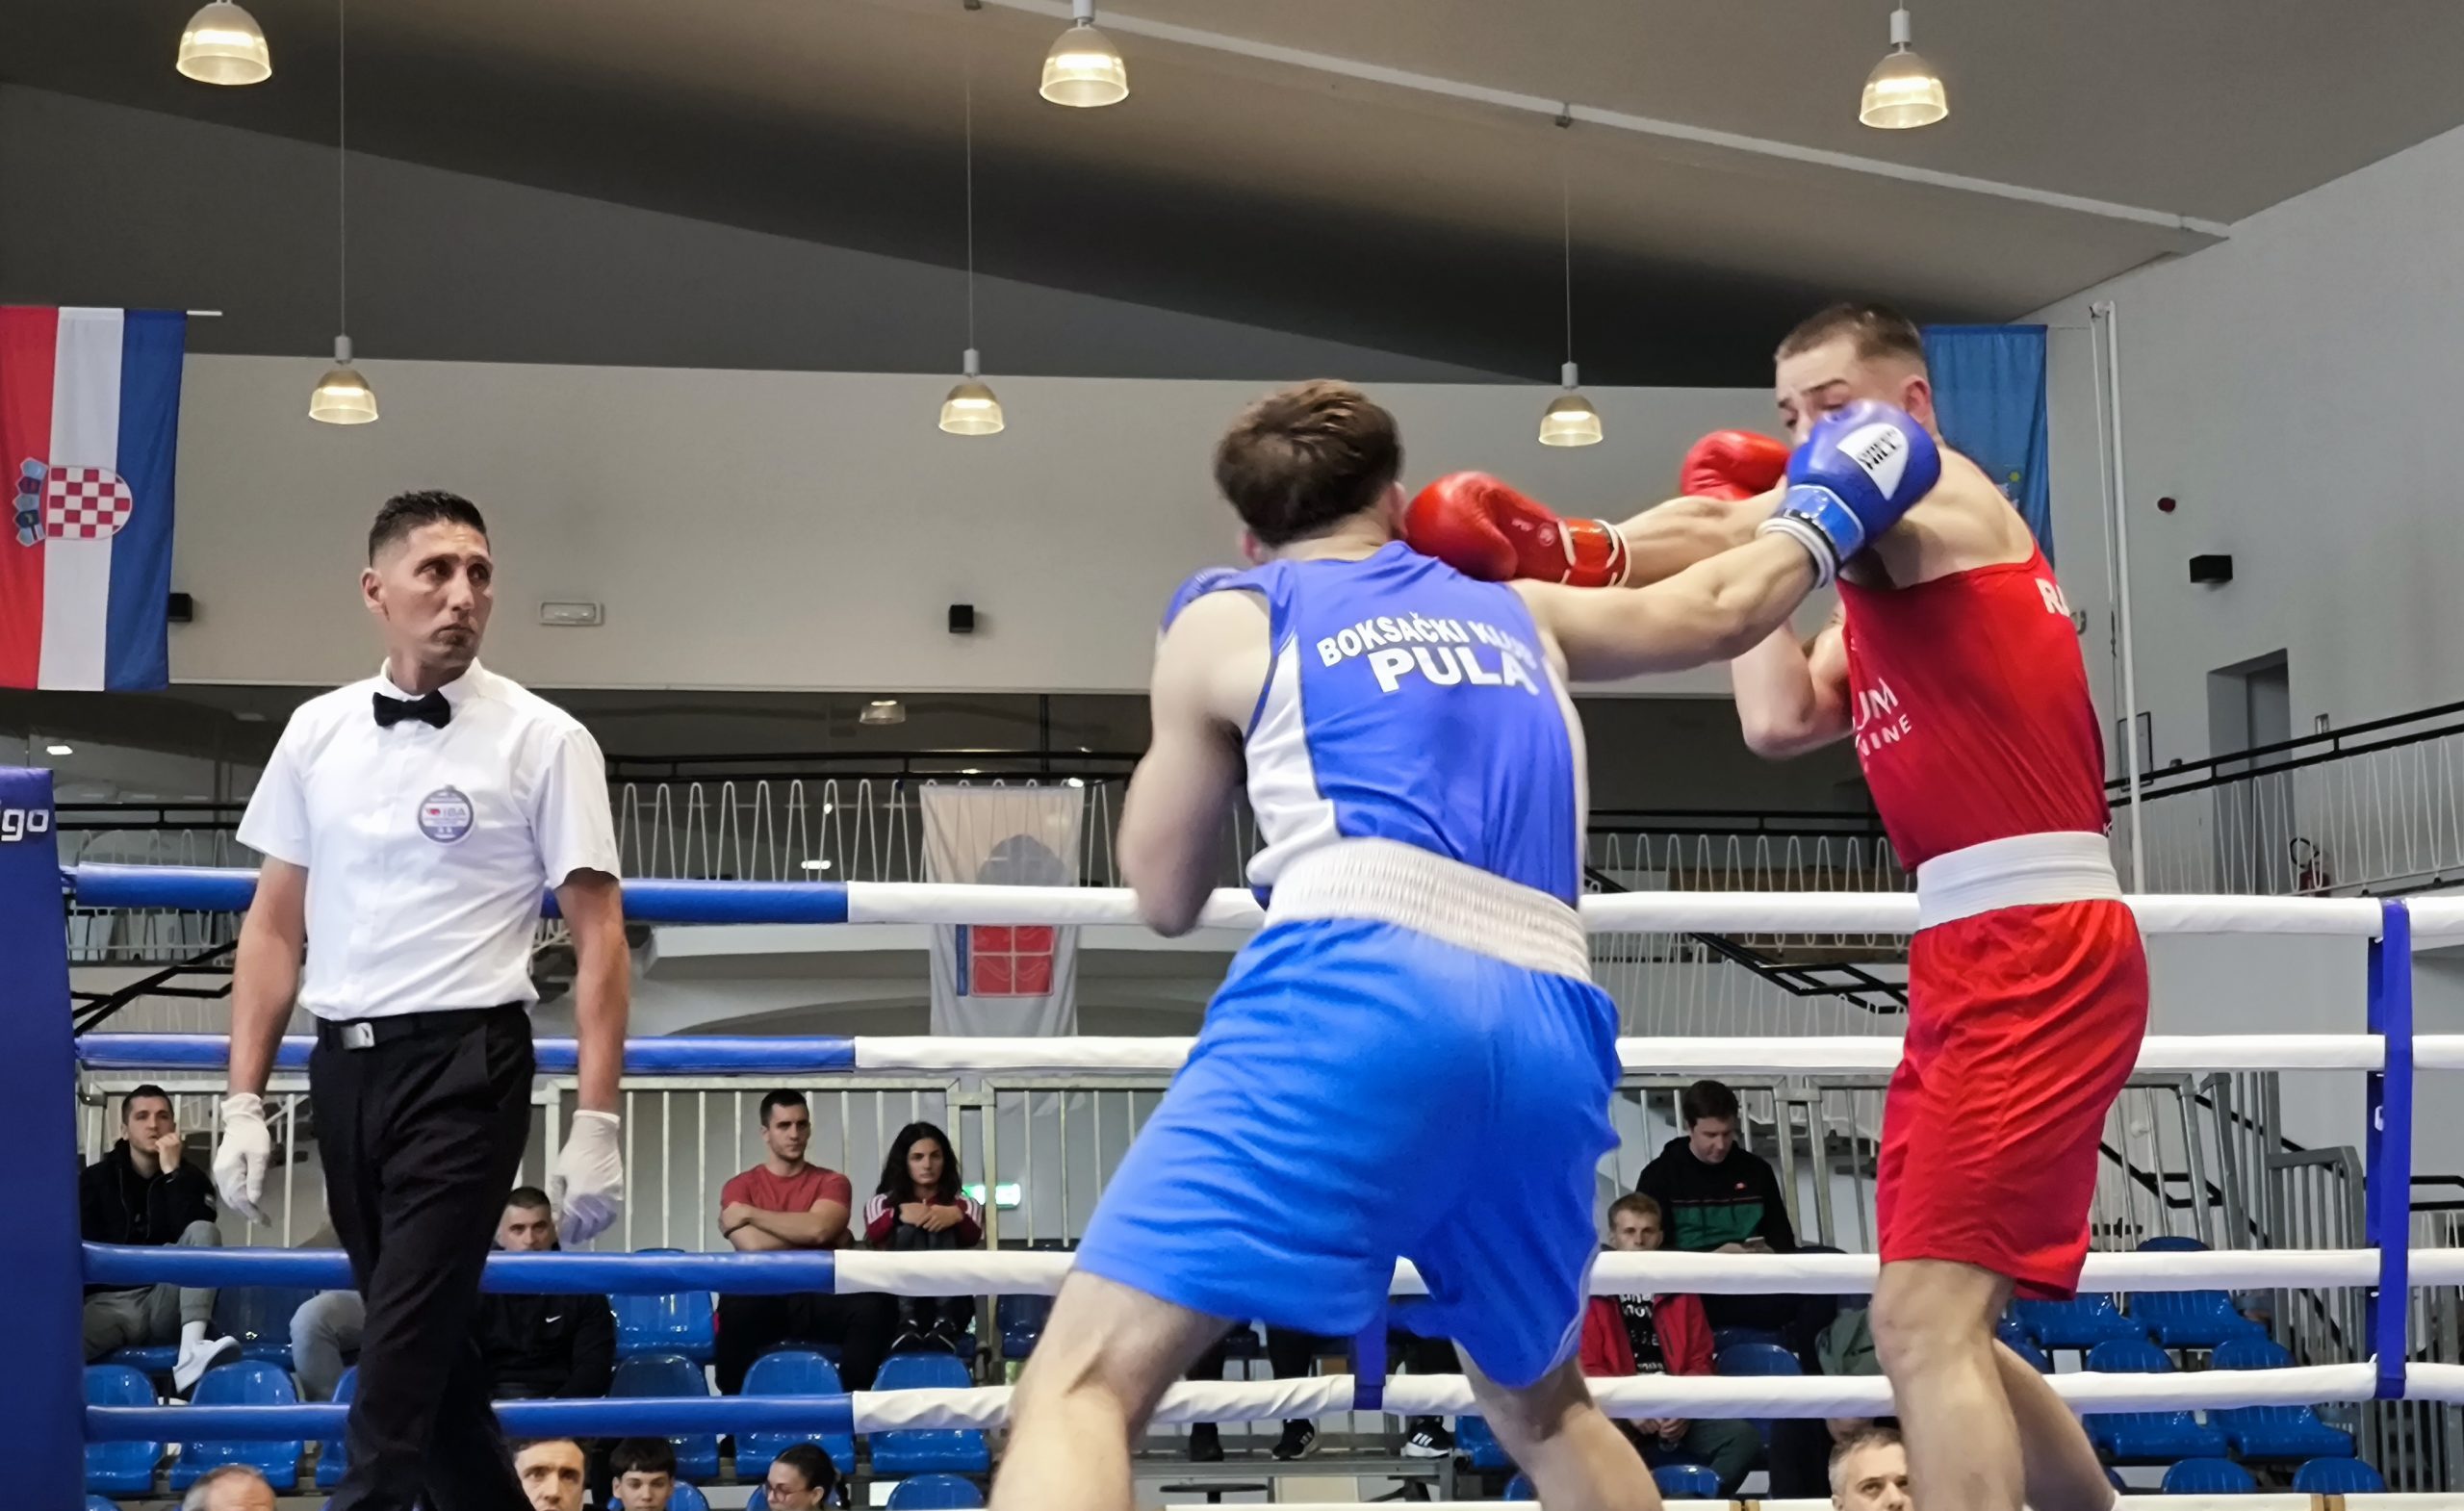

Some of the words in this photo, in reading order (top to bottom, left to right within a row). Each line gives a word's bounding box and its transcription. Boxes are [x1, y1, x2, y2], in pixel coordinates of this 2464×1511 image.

[1317, 611, 1470, 667] BOKSAČKI
[1367, 646, 1540, 697] PULA
[0, 808, 49, 842] go
